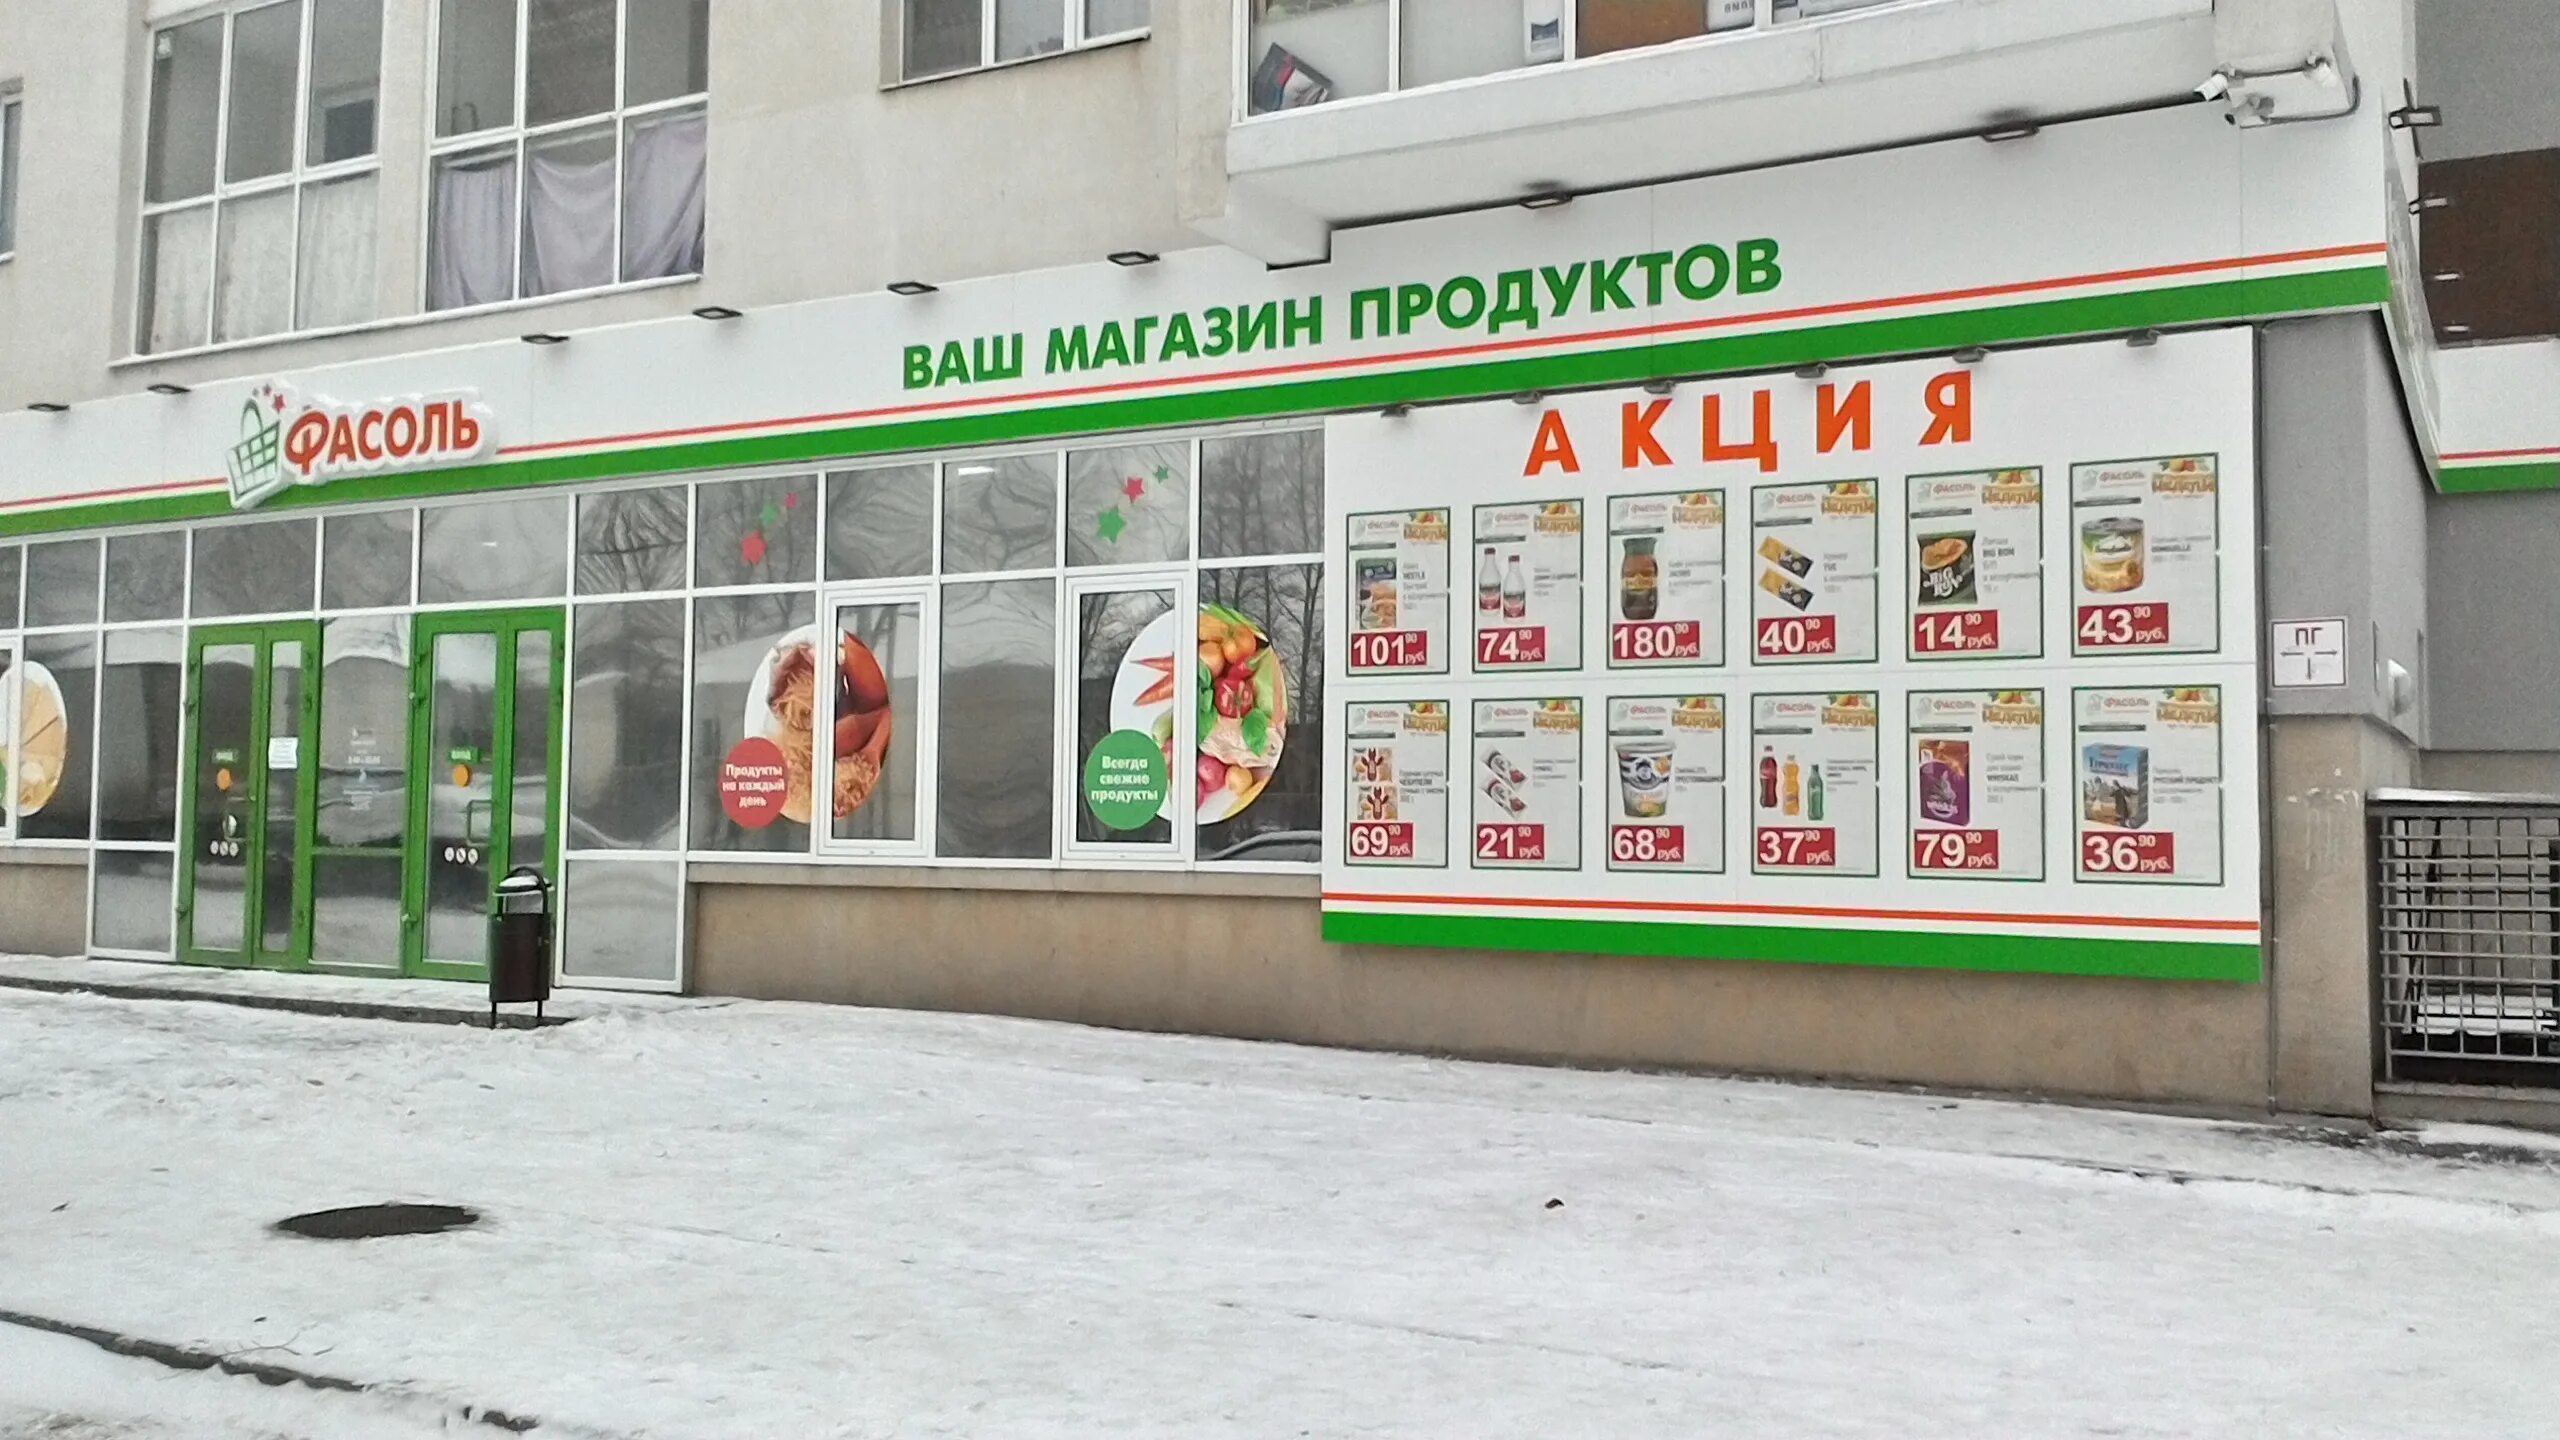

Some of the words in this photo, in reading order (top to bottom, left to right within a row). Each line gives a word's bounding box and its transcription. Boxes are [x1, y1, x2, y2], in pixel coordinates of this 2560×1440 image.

[904, 335, 1024, 390] ВАШ
[1046, 290, 1324, 373] МАГАЗИН
[1351, 239, 1783, 338] ПРОДУКТОВ
[1523, 370, 1973, 478] АКЦИЯ
[285, 401, 480, 475] ФАСОЛЬ
[1965, 613, 1982, 625] 90
[2134, 606, 2151, 618] 90
[1760, 620, 1805, 653] 40
[1918, 615, 1966, 649] 14
[2079, 608, 2134, 644] 43
[2135, 628, 2165, 643] руб.
[2296, 627, 2323, 646] ПГ
[1353, 635, 1405, 665] 101
[1479, 631, 1519, 661] 74
[1613, 625, 1676, 658] 180
[1967, 634, 1995, 648] руб.
[725, 763, 783, 779] Продукты
[1102, 755, 1148, 771] Всегда
[722, 781, 737, 792] на
[739, 778, 785, 793] каждый
[1099, 774, 1150, 785] свежие
[739, 796, 767, 809] день
[1091, 789, 1158, 804] продукты
[1351, 825, 1389, 856] 69
[1478, 827, 1515, 858] 21
[1613, 828, 1656, 860] 68
[1656, 827, 1670, 839] 90
[1760, 831, 1804, 863] 37
[1916, 833, 1966, 867] 79
[1966, 832, 1982, 844] 90
[2138, 835, 2156, 847] 90
[1967, 853, 1996, 867] руб.
[2085, 835, 2139, 872] 36
[2140, 856, 2170, 872] руб.
